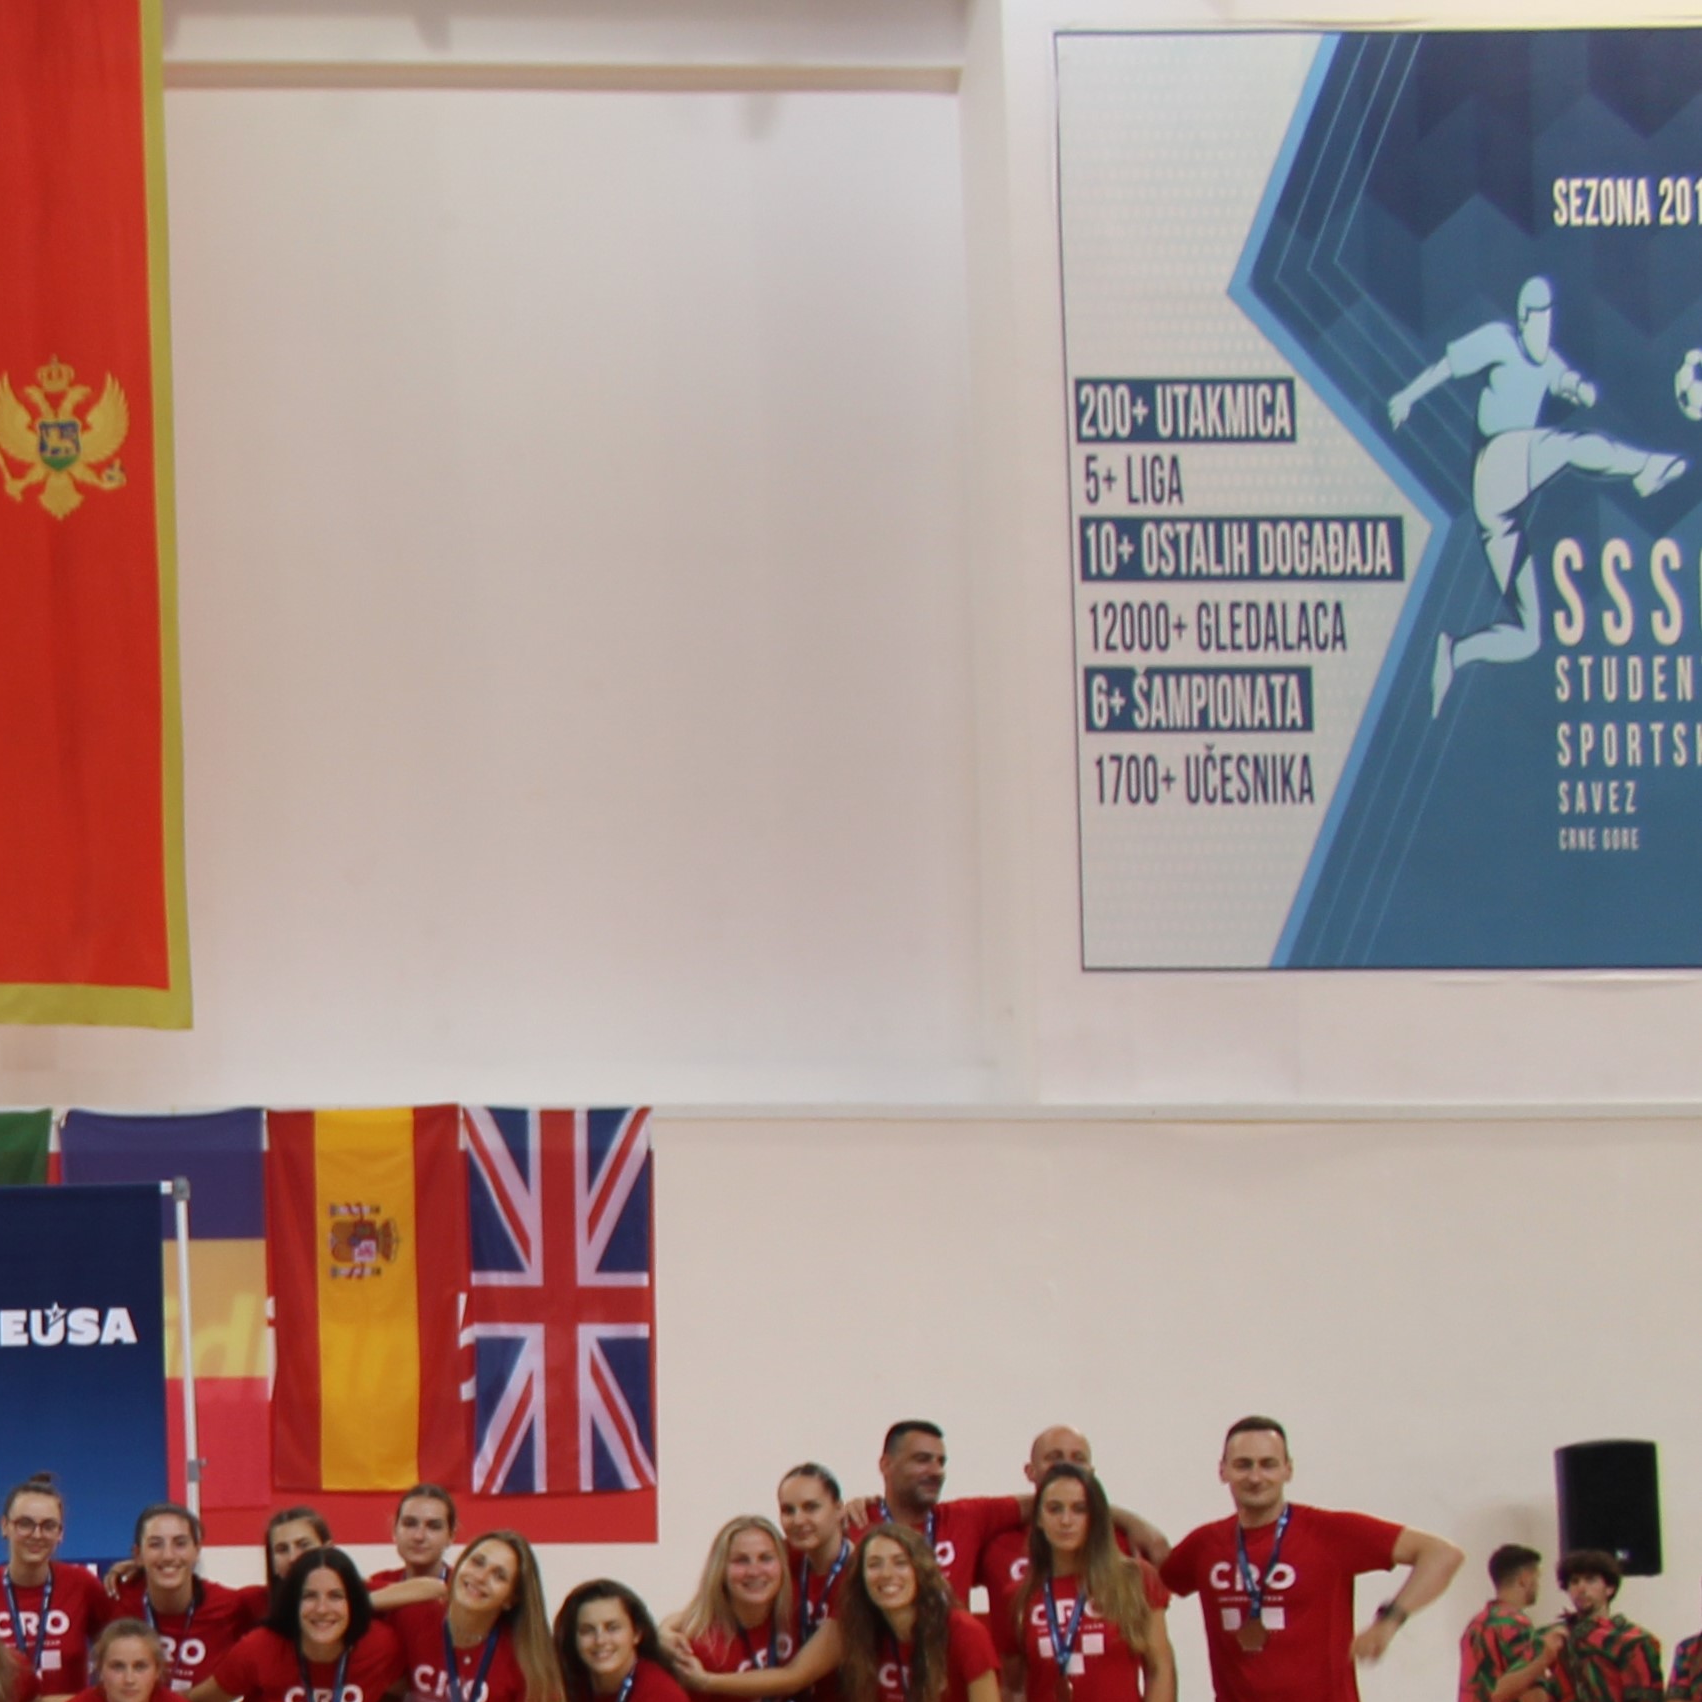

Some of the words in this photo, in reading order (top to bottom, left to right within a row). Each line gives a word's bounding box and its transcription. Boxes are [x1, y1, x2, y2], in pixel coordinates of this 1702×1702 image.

[1552, 177, 1651, 227] SEZONA
[1080, 384, 1149, 438] 200+
[1155, 383, 1293, 438] UTAKMICA
[1085, 454, 1117, 505] 5+
[1126, 453, 1184, 505] LIGA
[1086, 523, 1135, 576] 10+
[1141, 521, 1251, 577] OSTALIH
[1551, 537, 1702, 647] SSS
[1088, 600, 1188, 652] 12000+
[1197, 600, 1347, 652] GLEDALACA
[1091, 673, 1126, 729] 6+
[1132, 667, 1304, 730] ŠAMPIONATA
[1554, 655, 1702, 702] STUDEN
[1095, 753, 1176, 805] 1700+
[1185, 743, 1315, 806] UČESNIKA
[1557, 781, 1637, 815] SAVEZ
[1558, 827, 1596, 851] CRNE
[1602, 827, 1640, 851] GORE
[159, 1636, 207, 1665] RO
